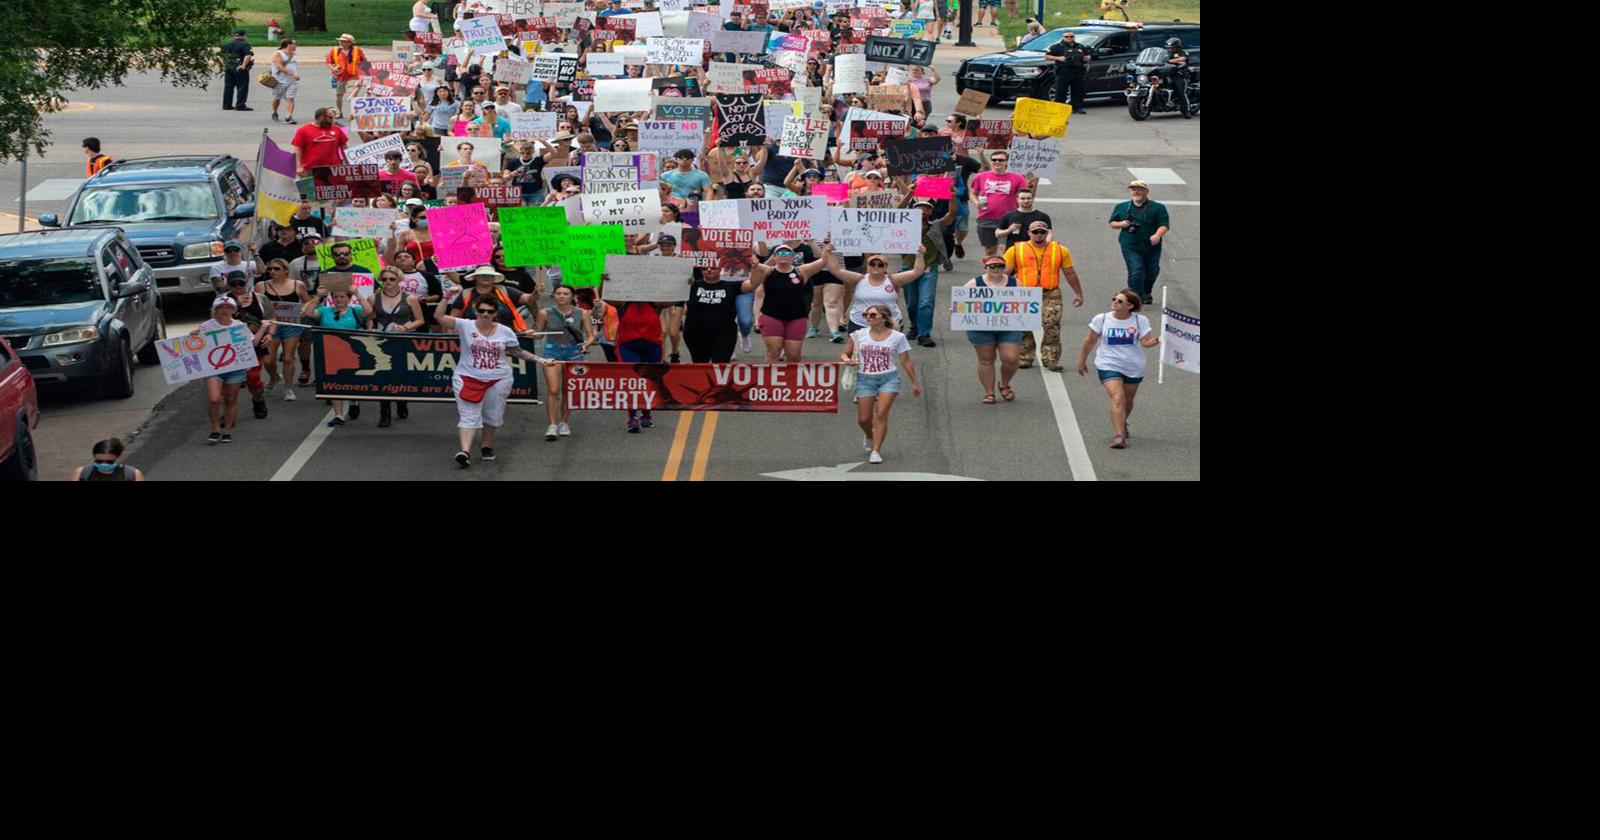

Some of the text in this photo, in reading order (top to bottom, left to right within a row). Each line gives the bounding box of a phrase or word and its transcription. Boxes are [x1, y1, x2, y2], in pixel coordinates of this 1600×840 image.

[505, 2, 535, 15] HER
[470, 19, 484, 28] I
[526, 16, 555, 26] VOTE NO
[607, 18, 625, 26] VOTE
[415, 32, 431, 40] VOTE
[464, 25, 500, 39] TRUST
[801, 30, 819, 38] VOTE
[466, 36, 503, 48] WOMEN
[371, 61, 404, 70] VOTE NO
[560, 66, 575, 75] NO
[755, 68, 789, 78] VOTE NO
[388, 73, 420, 86] VOTE NO
[354, 97, 396, 110] STAND
[384, 105, 407, 113] ROE
[662, 106, 704, 115] VOTE
[729, 105, 748, 114] NOT
[356, 113, 410, 130] VOTE NO
[644, 122, 698, 130] VOTE NO
[805, 119, 828, 132] LIE
[866, 120, 904, 130] VOTE NO
[980, 120, 1011, 129] VOTE NO
[851, 142, 881, 150] LIBERTY
[790, 148, 813, 157] DIE
[330, 164, 378, 176] VOTE NO
[584, 167, 637, 179] BOOK OF
[316, 190, 353, 200] LIBERTY
[474, 187, 521, 198] VOTE NO
[616, 197, 646, 205] BODY
[751, 199, 813, 212] NOT YOUR
[609, 208, 625, 216] MY
[767, 210, 799, 220] BODY
[838, 209, 913, 224] A MOTHER
[753, 220, 811, 230] NOT YOUR
[702, 230, 752, 242] VOTE NO
[695, 258, 721, 268] ERTY
[697, 287, 715, 298] VOTE
[953, 289, 966, 297] SO
[969, 288, 994, 299] BAD
[952, 301, 1040, 314] INTROVERTS
[961, 315, 1010, 327] ARE HERE
[161, 325, 247, 359] VOTE
[406, 352, 527, 375] MAH
[473, 359, 501, 369] FACE
[712, 363, 837, 387] VOTE NO
[322, 381, 380, 391] Women's
[382, 384, 418, 393] rights
[567, 377, 648, 391] STAND FOR
[567, 390, 657, 410] LIBERTY
[748, 387, 834, 403] 08.02.2022
